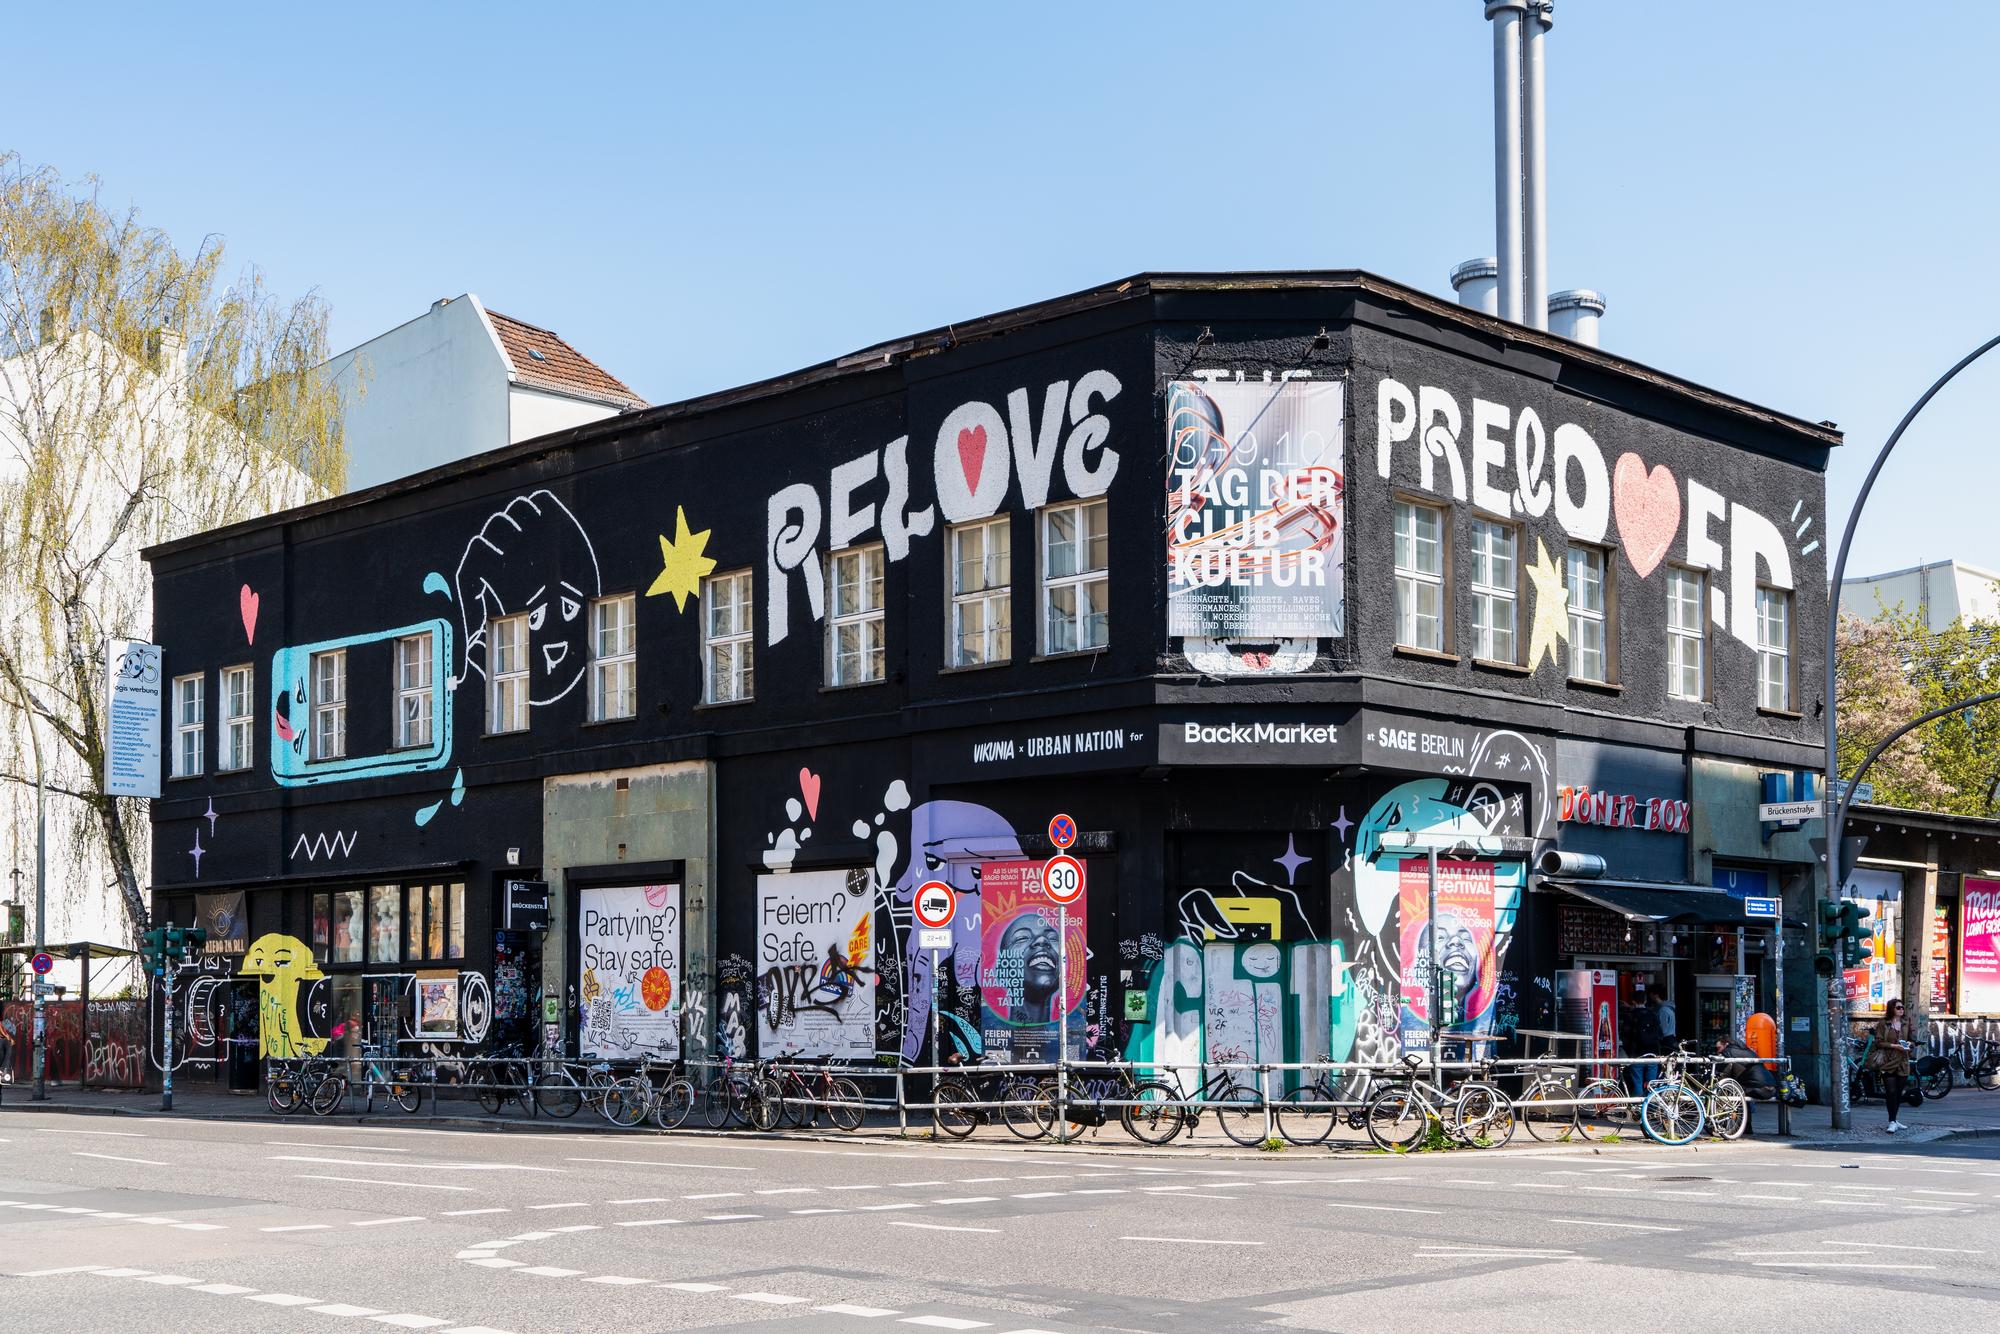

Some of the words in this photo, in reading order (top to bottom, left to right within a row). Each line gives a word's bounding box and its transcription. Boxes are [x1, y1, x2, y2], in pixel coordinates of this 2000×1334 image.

[1174, 468, 1249, 507] TAG
[1259, 468, 1337, 507] DER
[1174, 509, 1280, 548] CLUB
[1174, 549, 1326, 588] KULTUR
[1203, 622, 1218, 630] UND
[130, 685, 159, 697] werbung
[1027, 734, 1071, 757] URBAN
[1075, 729, 1124, 753] NATION
[1129, 732, 1143, 741] for
[1366, 732, 1375, 741] at
[1378, 727, 1417, 751] SAGE
[1421, 733, 1464, 758] BERLIN
[1558, 785, 1637, 828] DÖNER
[1644, 797, 1690, 833] BOX
[1767, 804, 1815, 816] Brückenstraße
[1052, 868, 1075, 890] 30
[1436, 867, 1462, 880] TAM
[1464, 868, 1491, 881] TAM
[1729, 871, 1737, 888] U
[1437, 880, 1491, 895] FESTIVAL
[542, 896, 548, 910] 1
[763, 893, 846, 926] Feiern?
[585, 906, 677, 943] Partying?
[763, 932, 818, 962] Safe.
[848, 937, 868, 953] CARE
[585, 943, 627, 978] Stay
[630, 941, 677, 970] safe.
[996, 959, 1025, 968] FOOD
[983, 968, 1025, 978] FASHION
[982, 978, 1025, 988] MARKET
[1006, 988, 1025, 997] ART
[997, 998, 1025, 1007] TALKS
[984, 1030, 1012, 1038] FEIERN
[984, 1038, 1008, 1047] HILFT!
[1405, 1039, 1427, 1047] HILFT!
